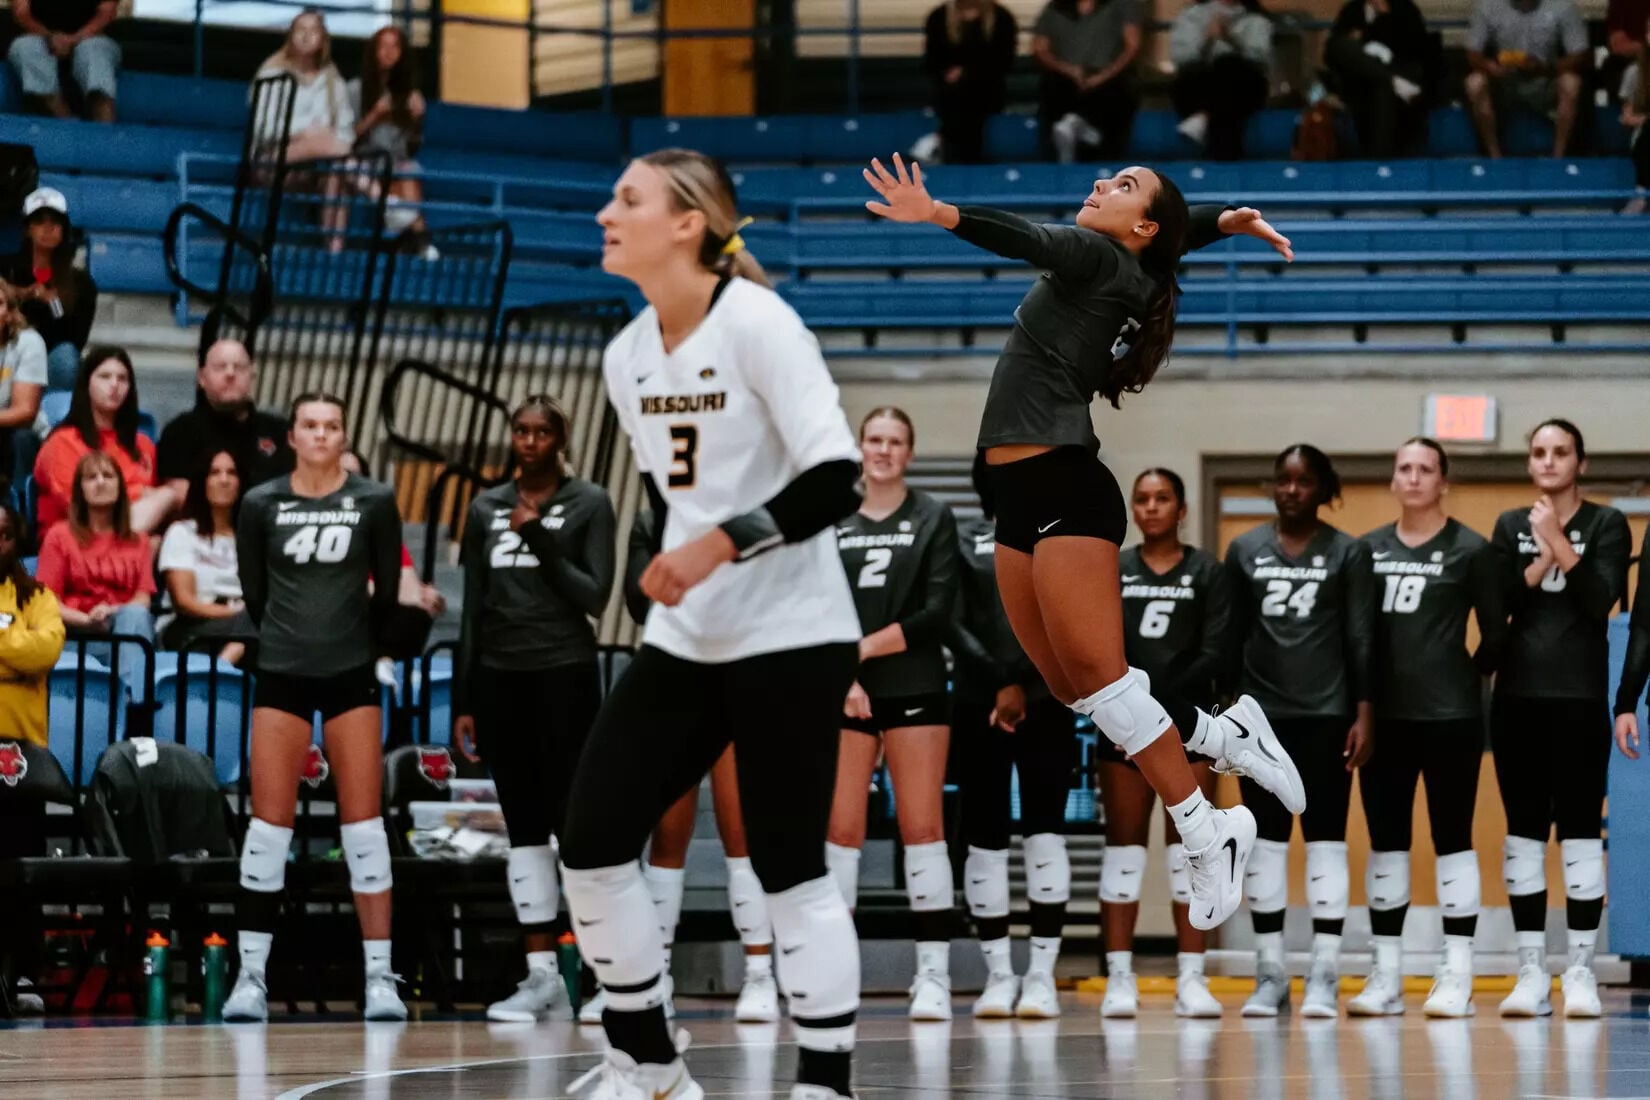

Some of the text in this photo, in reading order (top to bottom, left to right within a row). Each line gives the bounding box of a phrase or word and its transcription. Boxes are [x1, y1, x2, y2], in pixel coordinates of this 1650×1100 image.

[667, 424, 699, 490] 3
[276, 511, 360, 525] MISSOURI
[283, 525, 353, 564] 40
[857, 547, 893, 588] 2
[1261, 580, 1319, 618] 24
[1382, 575, 1427, 613] 18
[1139, 600, 1177, 639] 6
